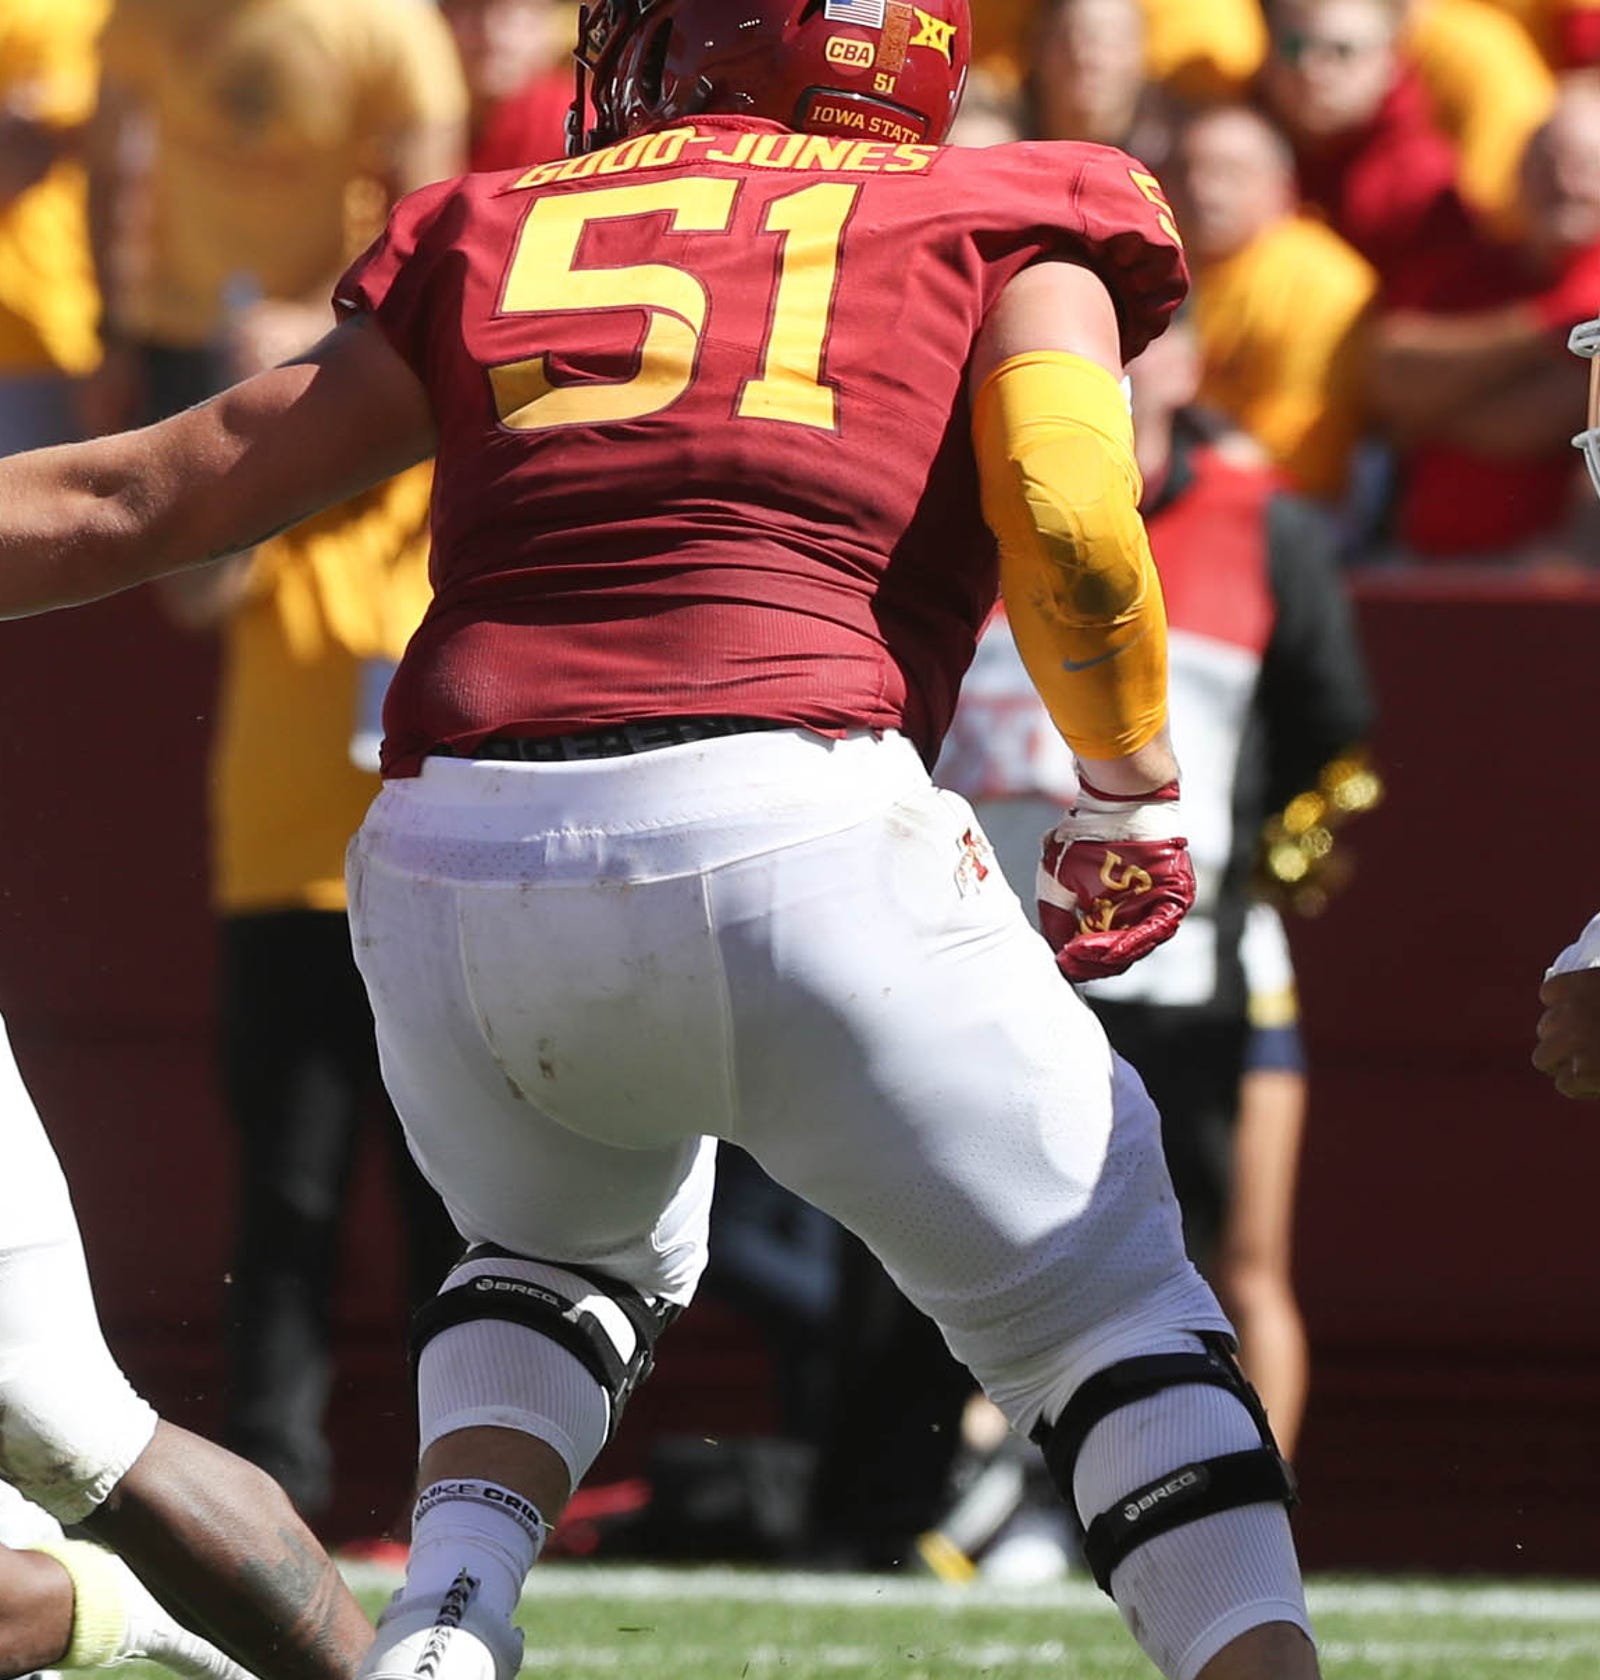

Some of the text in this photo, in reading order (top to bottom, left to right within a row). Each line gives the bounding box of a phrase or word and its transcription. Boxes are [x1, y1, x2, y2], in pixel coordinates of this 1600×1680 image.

[828, 41, 870, 64] CBA
[873, 72, 896, 94] 51
[811, 106, 920, 145] IOWA STATE
[488, 176, 864, 434] 51
[483, 1487, 539, 1526] GRIP
[1138, 1471, 1197, 1511] BREG
